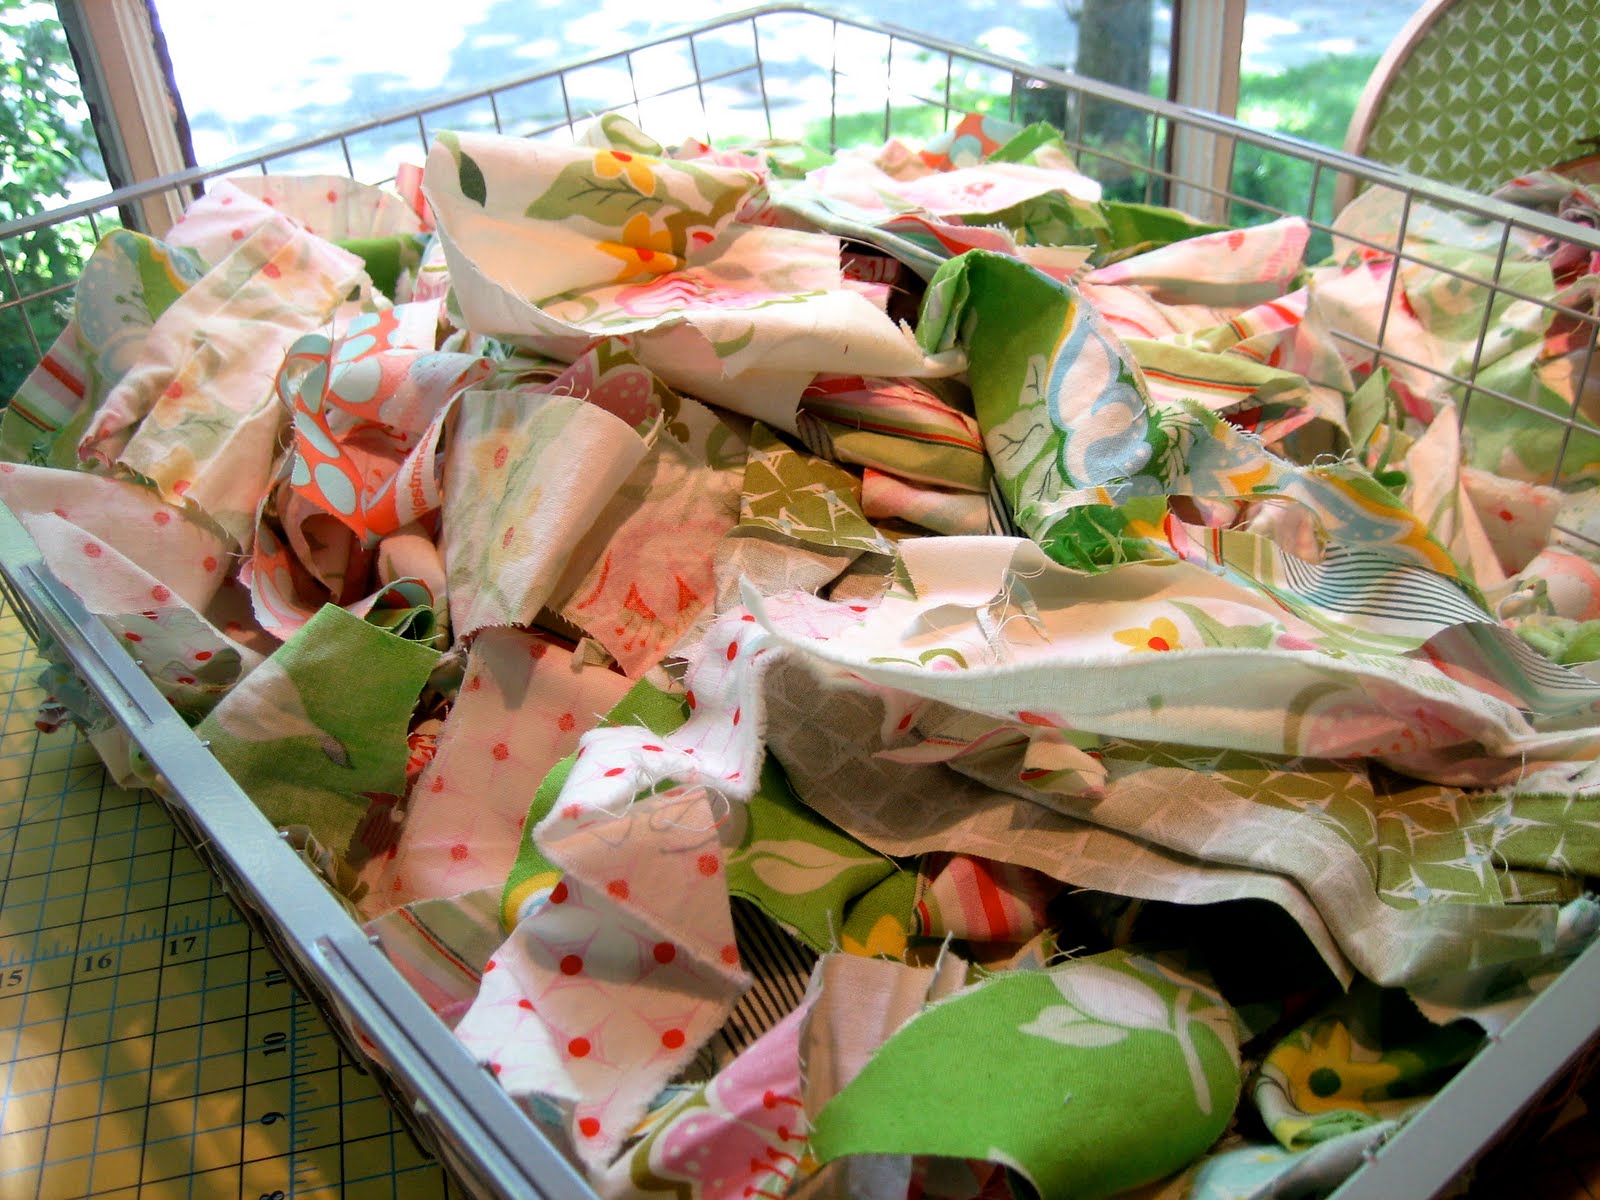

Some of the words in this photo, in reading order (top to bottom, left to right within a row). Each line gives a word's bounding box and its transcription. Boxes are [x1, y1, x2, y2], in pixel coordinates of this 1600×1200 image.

[83, 952, 113, 972] 16
[168, 936, 197, 956] 17
[265, 969, 287, 987] 11
[263, 1032, 287, 1056] 10
[261, 1112, 286, 1125] 9
